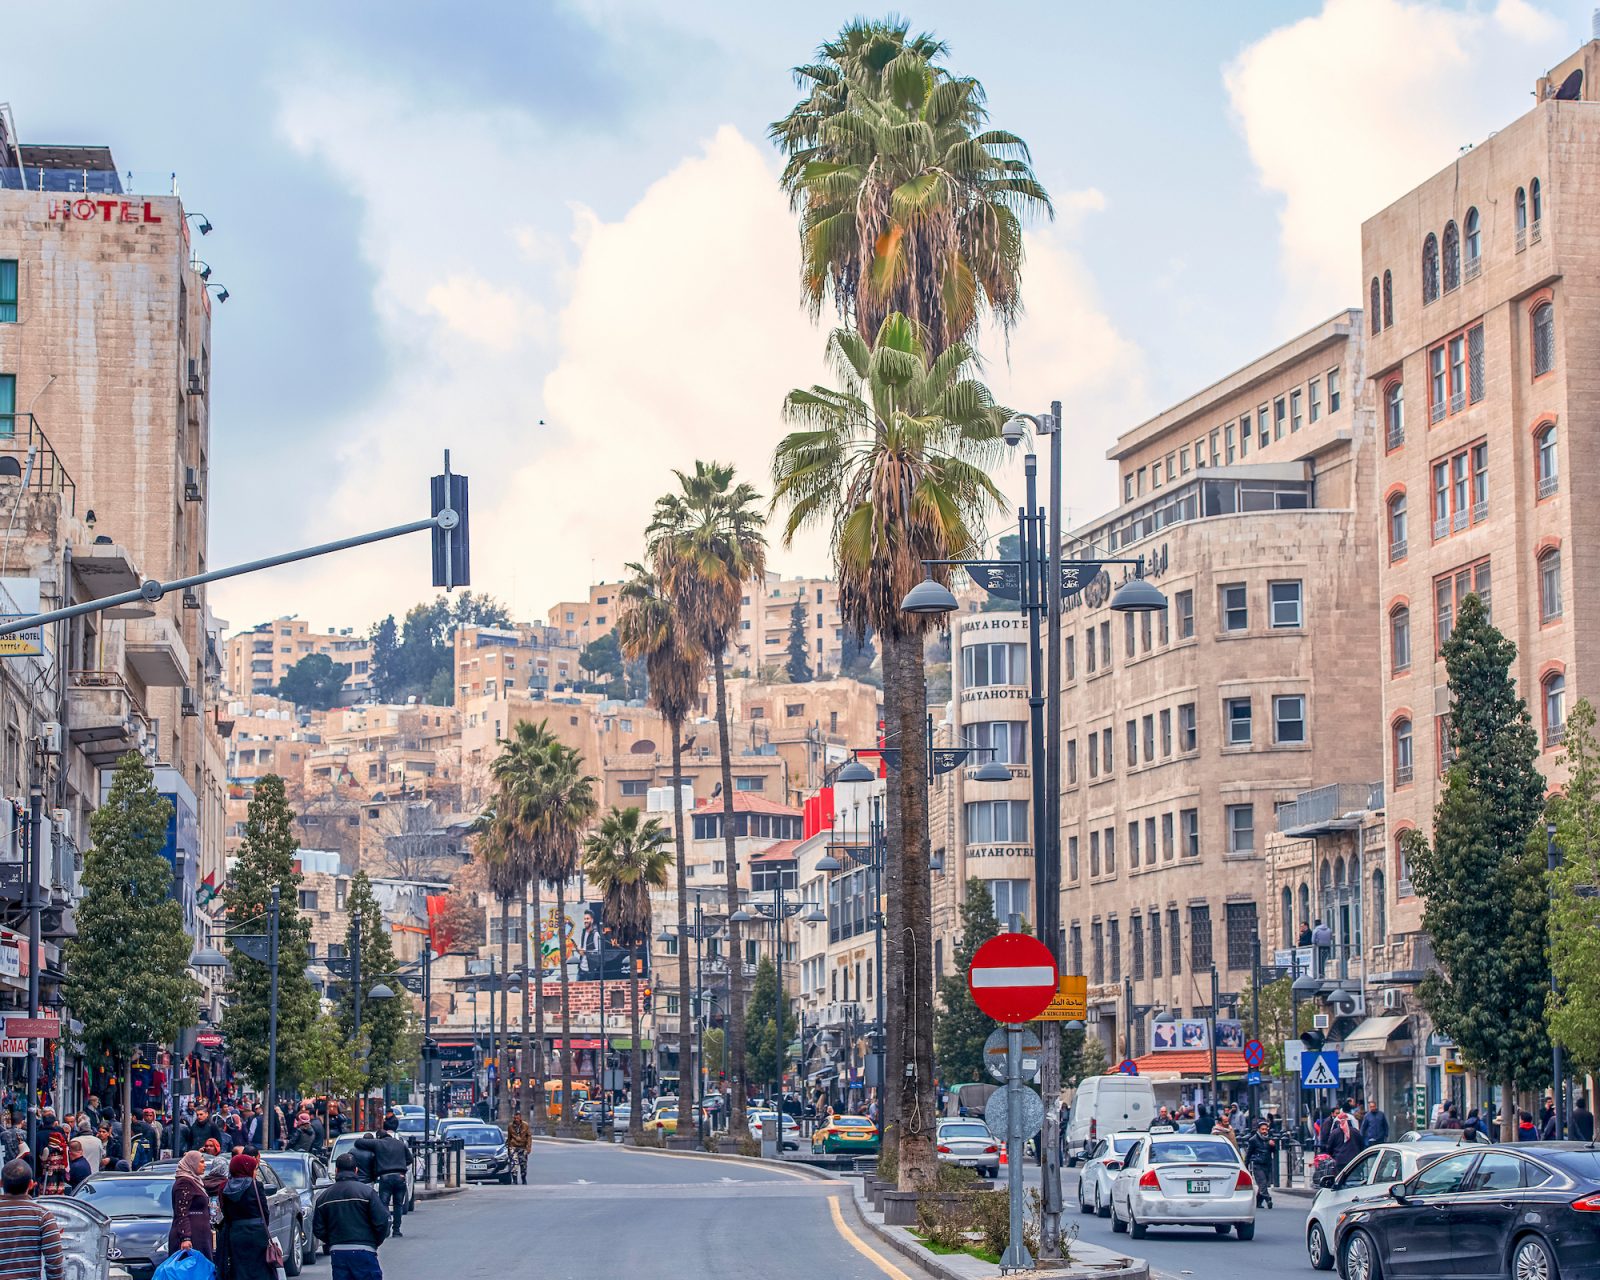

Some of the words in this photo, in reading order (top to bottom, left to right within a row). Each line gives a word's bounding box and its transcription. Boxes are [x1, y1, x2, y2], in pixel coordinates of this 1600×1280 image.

[48, 199, 162, 223] HOTEL
[991, 620, 1029, 629] HOTE
[19, 632, 41, 640] HOTEL
[1065, 998, 1083, 1006] ساحة
